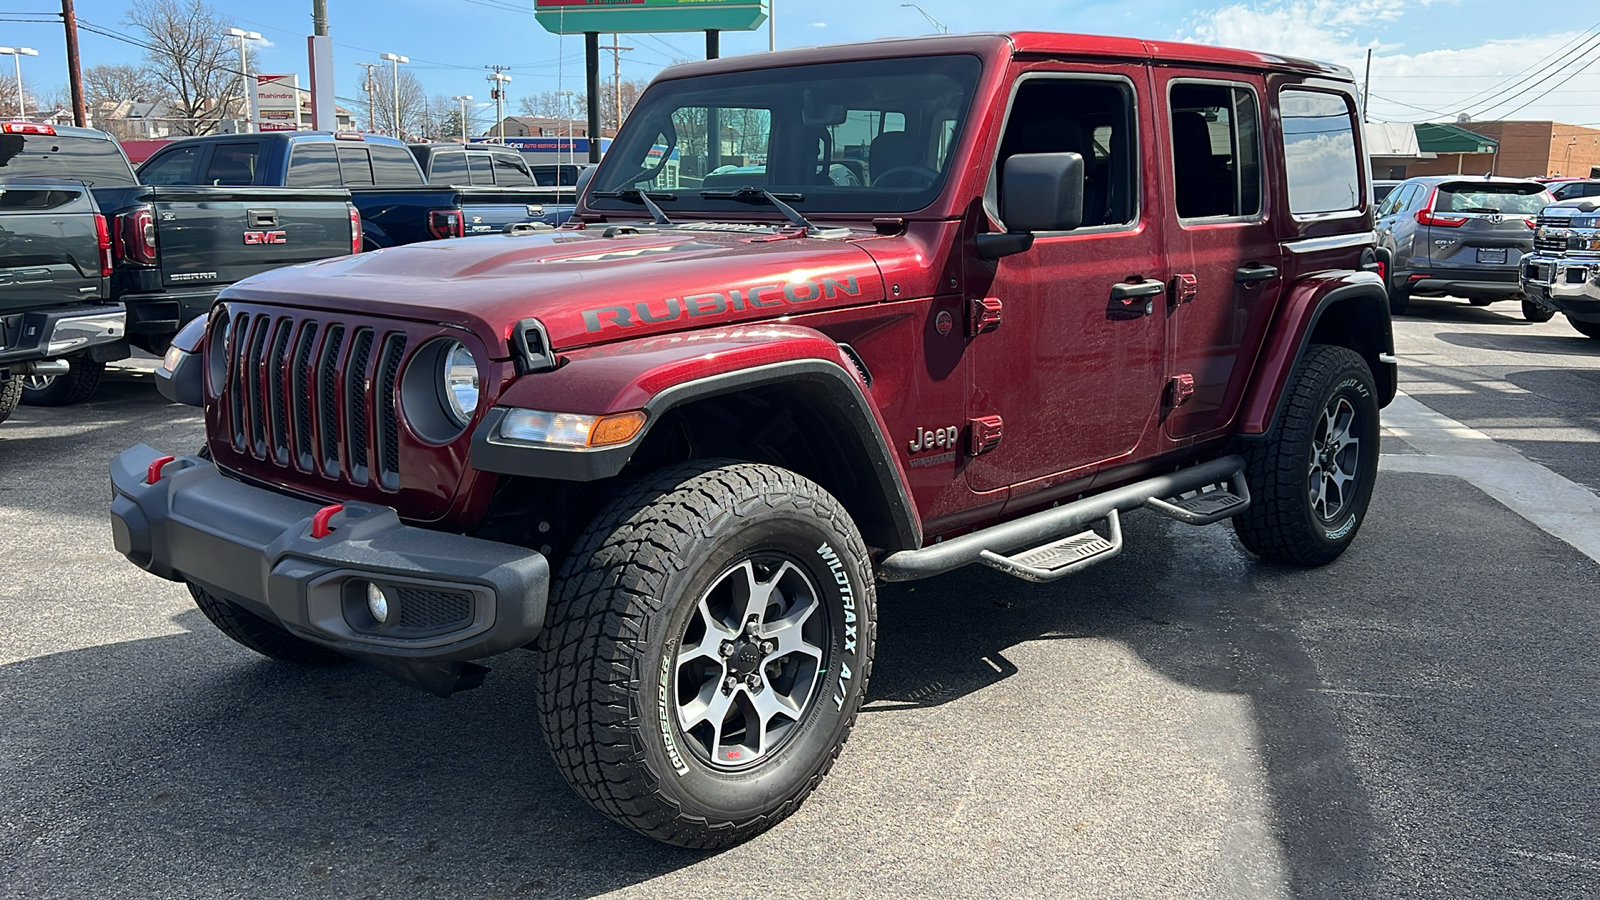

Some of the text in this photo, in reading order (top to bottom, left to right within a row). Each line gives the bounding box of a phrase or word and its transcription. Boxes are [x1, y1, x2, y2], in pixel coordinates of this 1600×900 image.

[243, 230, 287, 245] GMC
[170, 271, 217, 281] SIERRA
[580, 274, 862, 334] RUBICON
[908, 425, 959, 452] Jeep
[816, 541, 857, 712] WILDTRAXX A/T
[657, 654, 690, 777] LANDSPIDER
